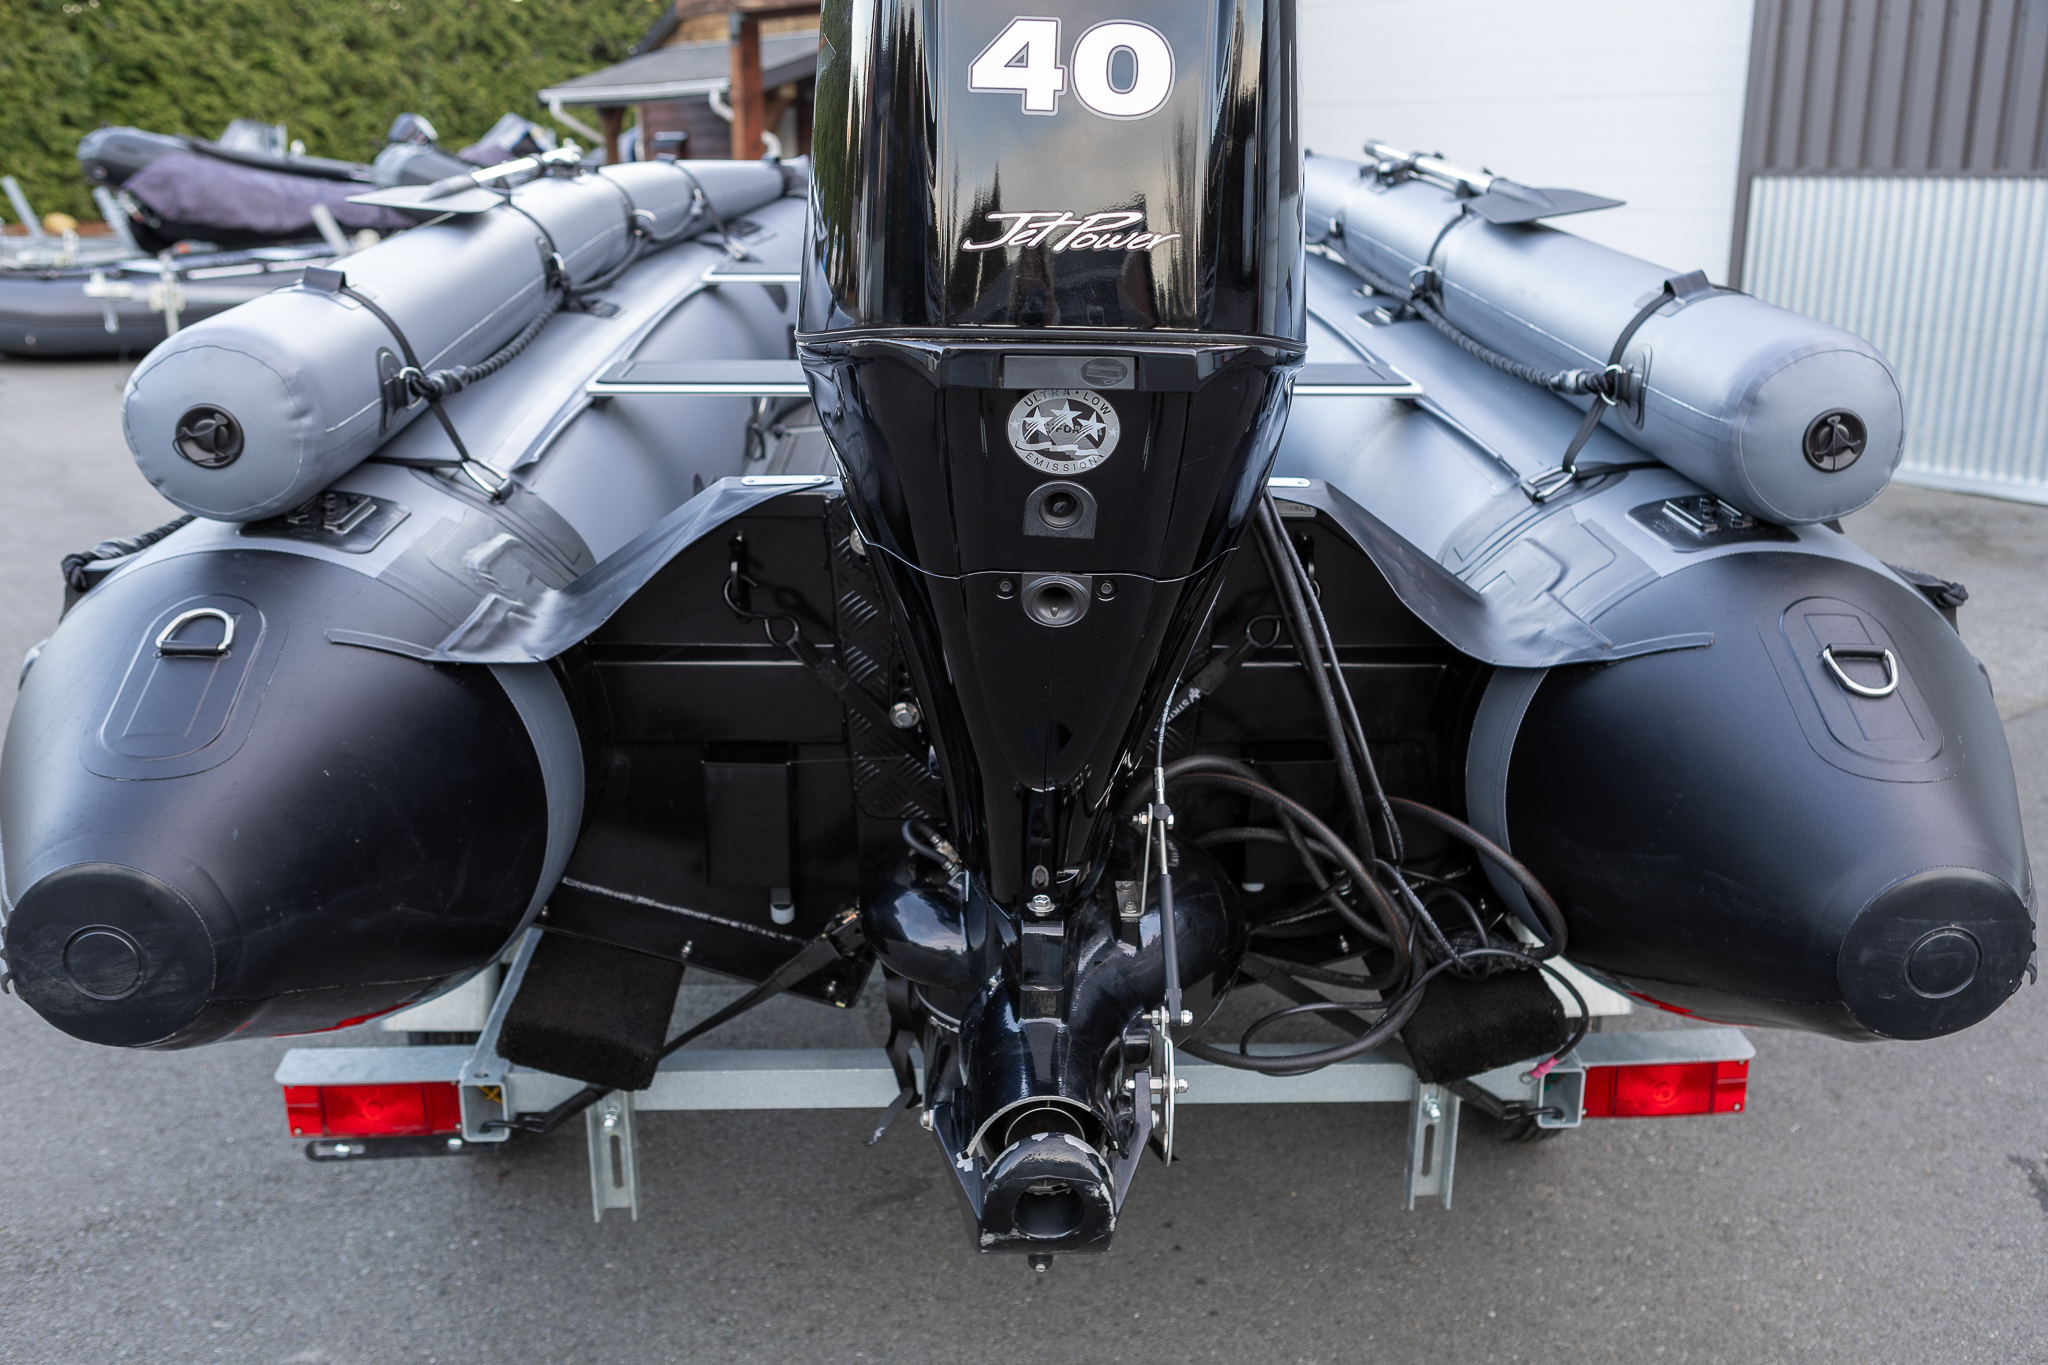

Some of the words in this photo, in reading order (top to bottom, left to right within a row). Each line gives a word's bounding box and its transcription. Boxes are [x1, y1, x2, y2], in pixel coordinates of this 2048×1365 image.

[968, 16, 1176, 121] 40
[1083, 391, 1111, 415] LOW
[1025, 452, 1098, 472] EMISSION
